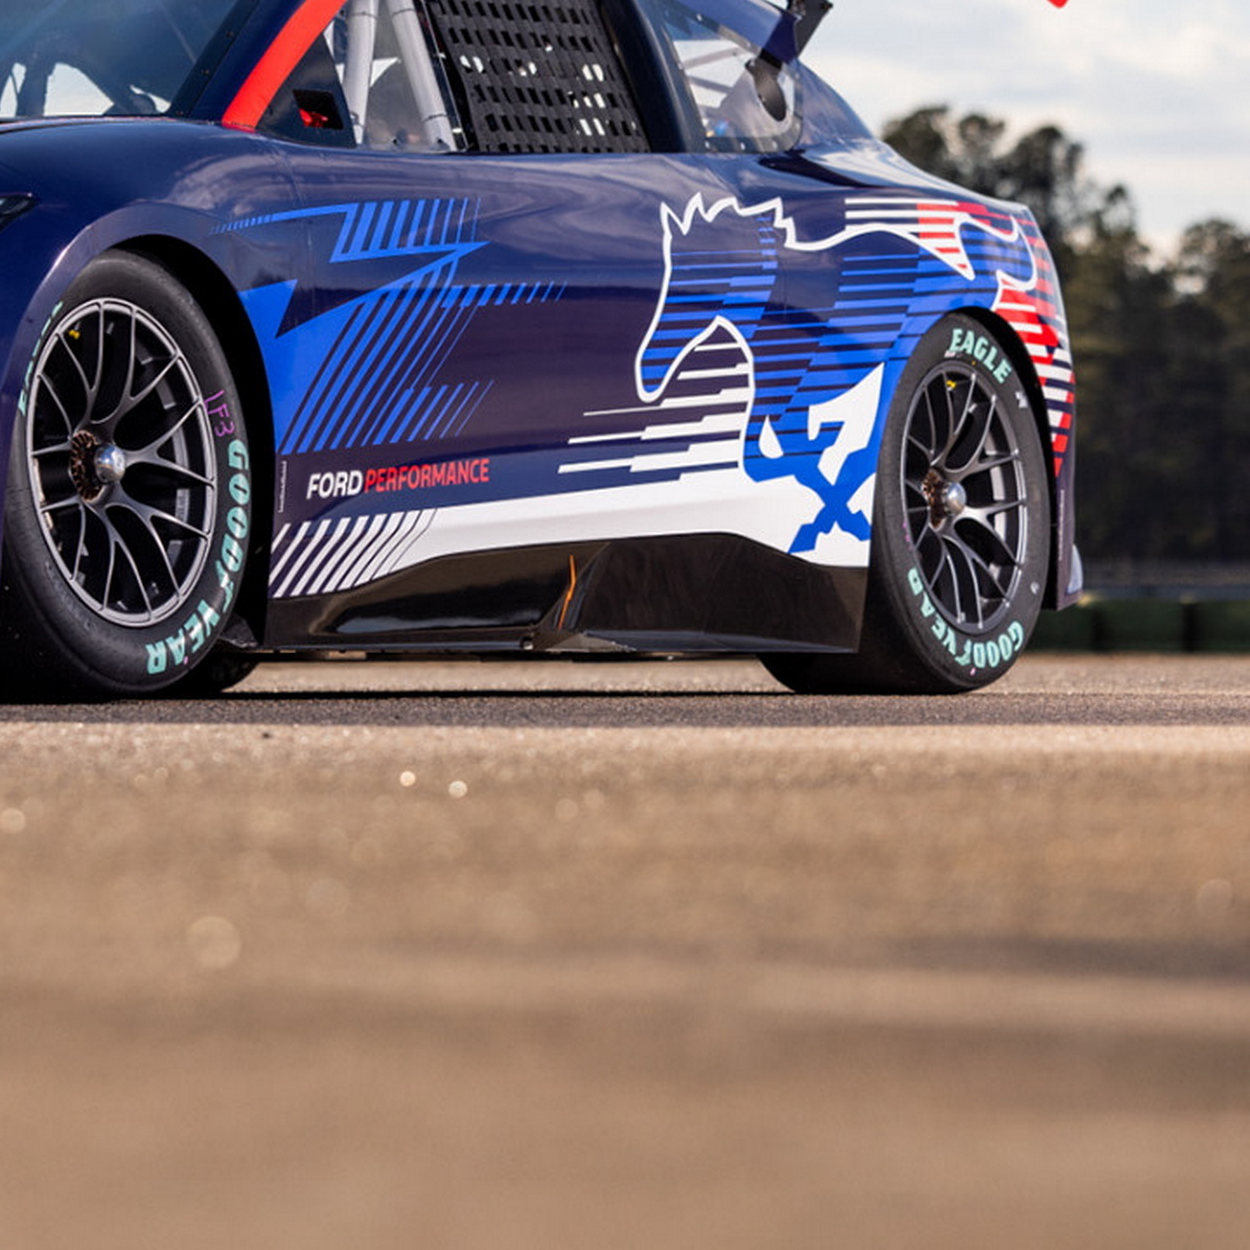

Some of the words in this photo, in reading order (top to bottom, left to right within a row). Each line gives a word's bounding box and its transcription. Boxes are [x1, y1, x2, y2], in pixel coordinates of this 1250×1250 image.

[949, 328, 1012, 384] EAGLE
[203, 389, 235, 437] LF3
[306, 469, 364, 500] FORD
[363, 458, 490, 493] PERFORMANCE
